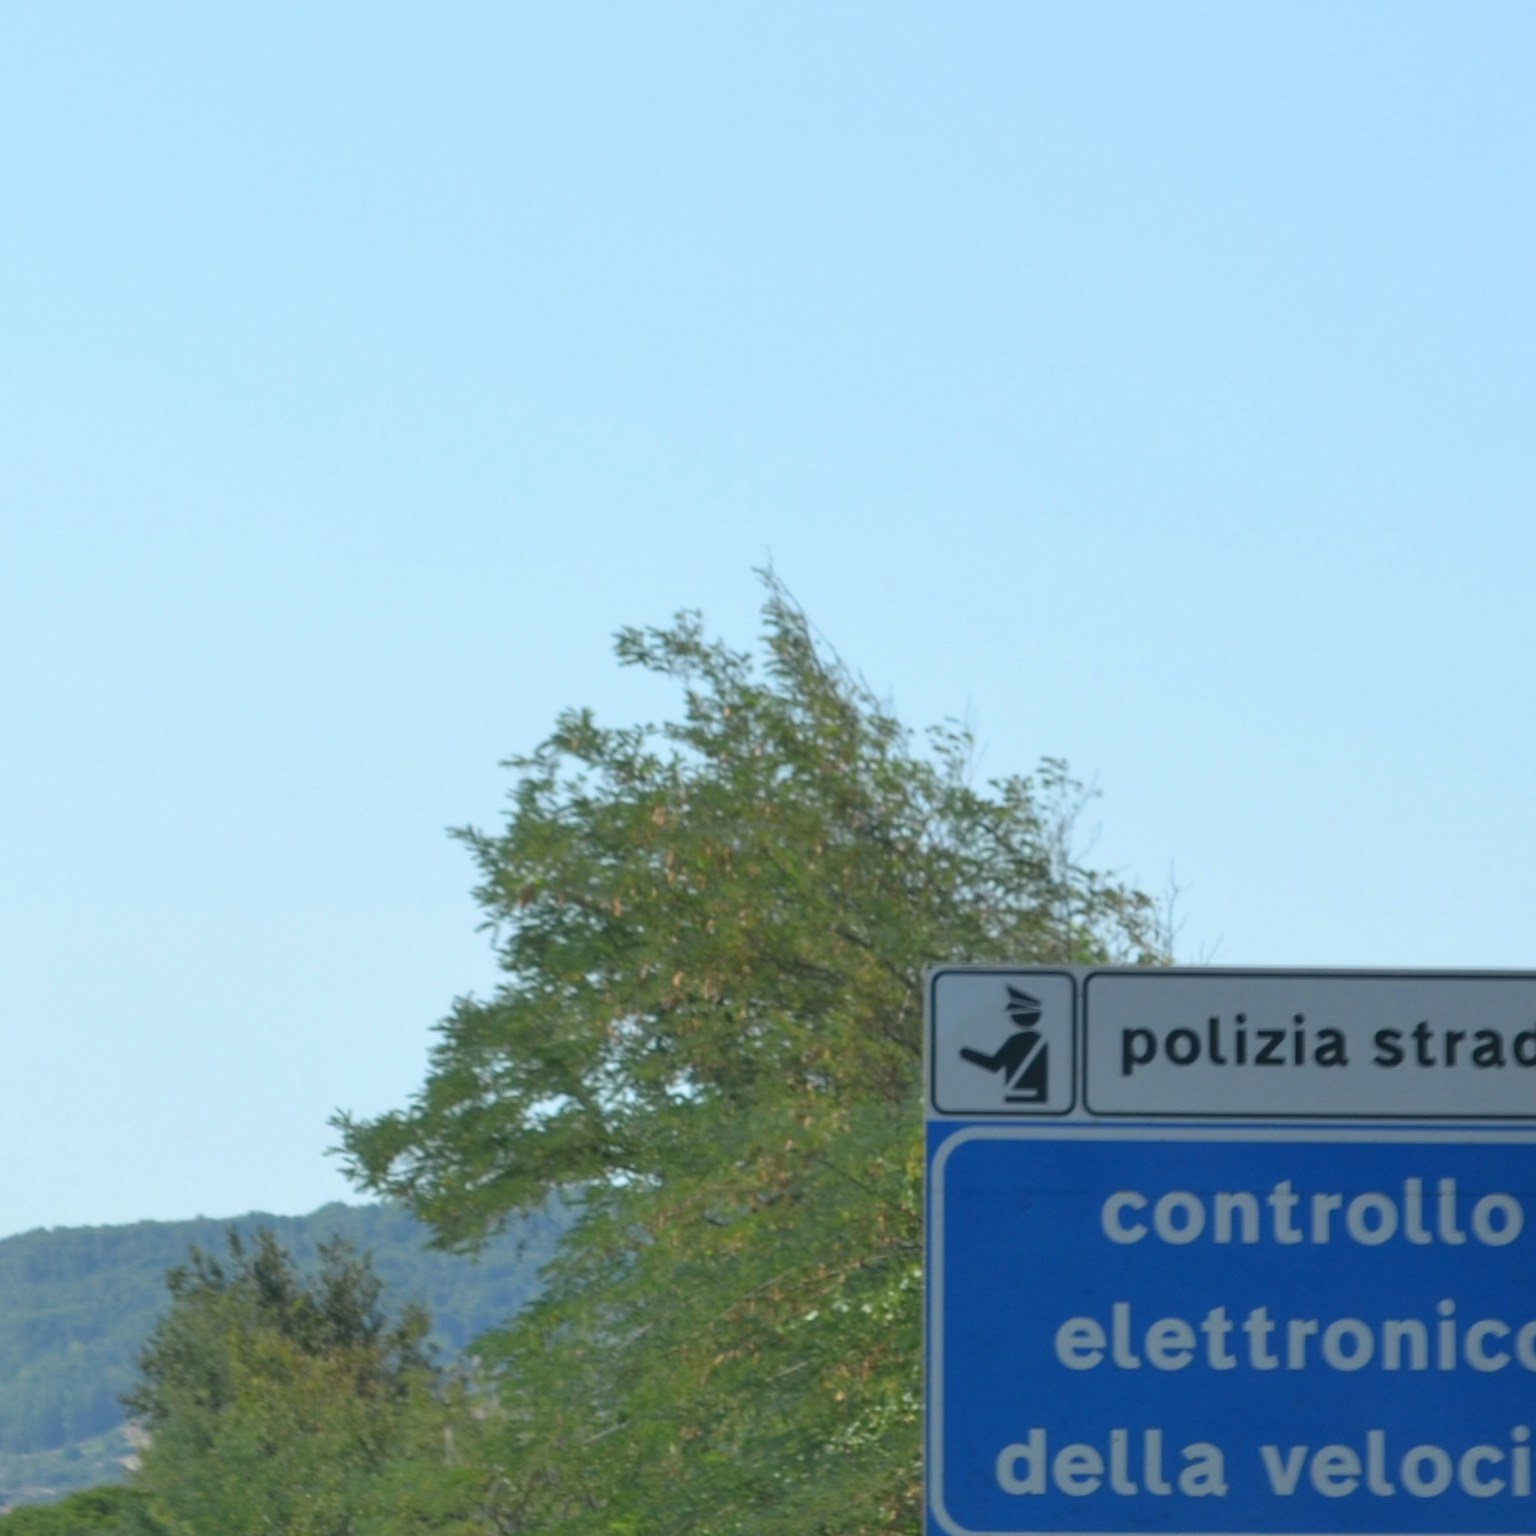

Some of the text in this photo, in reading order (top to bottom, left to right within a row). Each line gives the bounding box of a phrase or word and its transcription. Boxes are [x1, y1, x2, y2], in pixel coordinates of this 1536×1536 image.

[1120, 1012, 1350, 1077] polizia
[1100, 1176, 1525, 1247] controllo
[995, 1427, 1229, 1498] della
